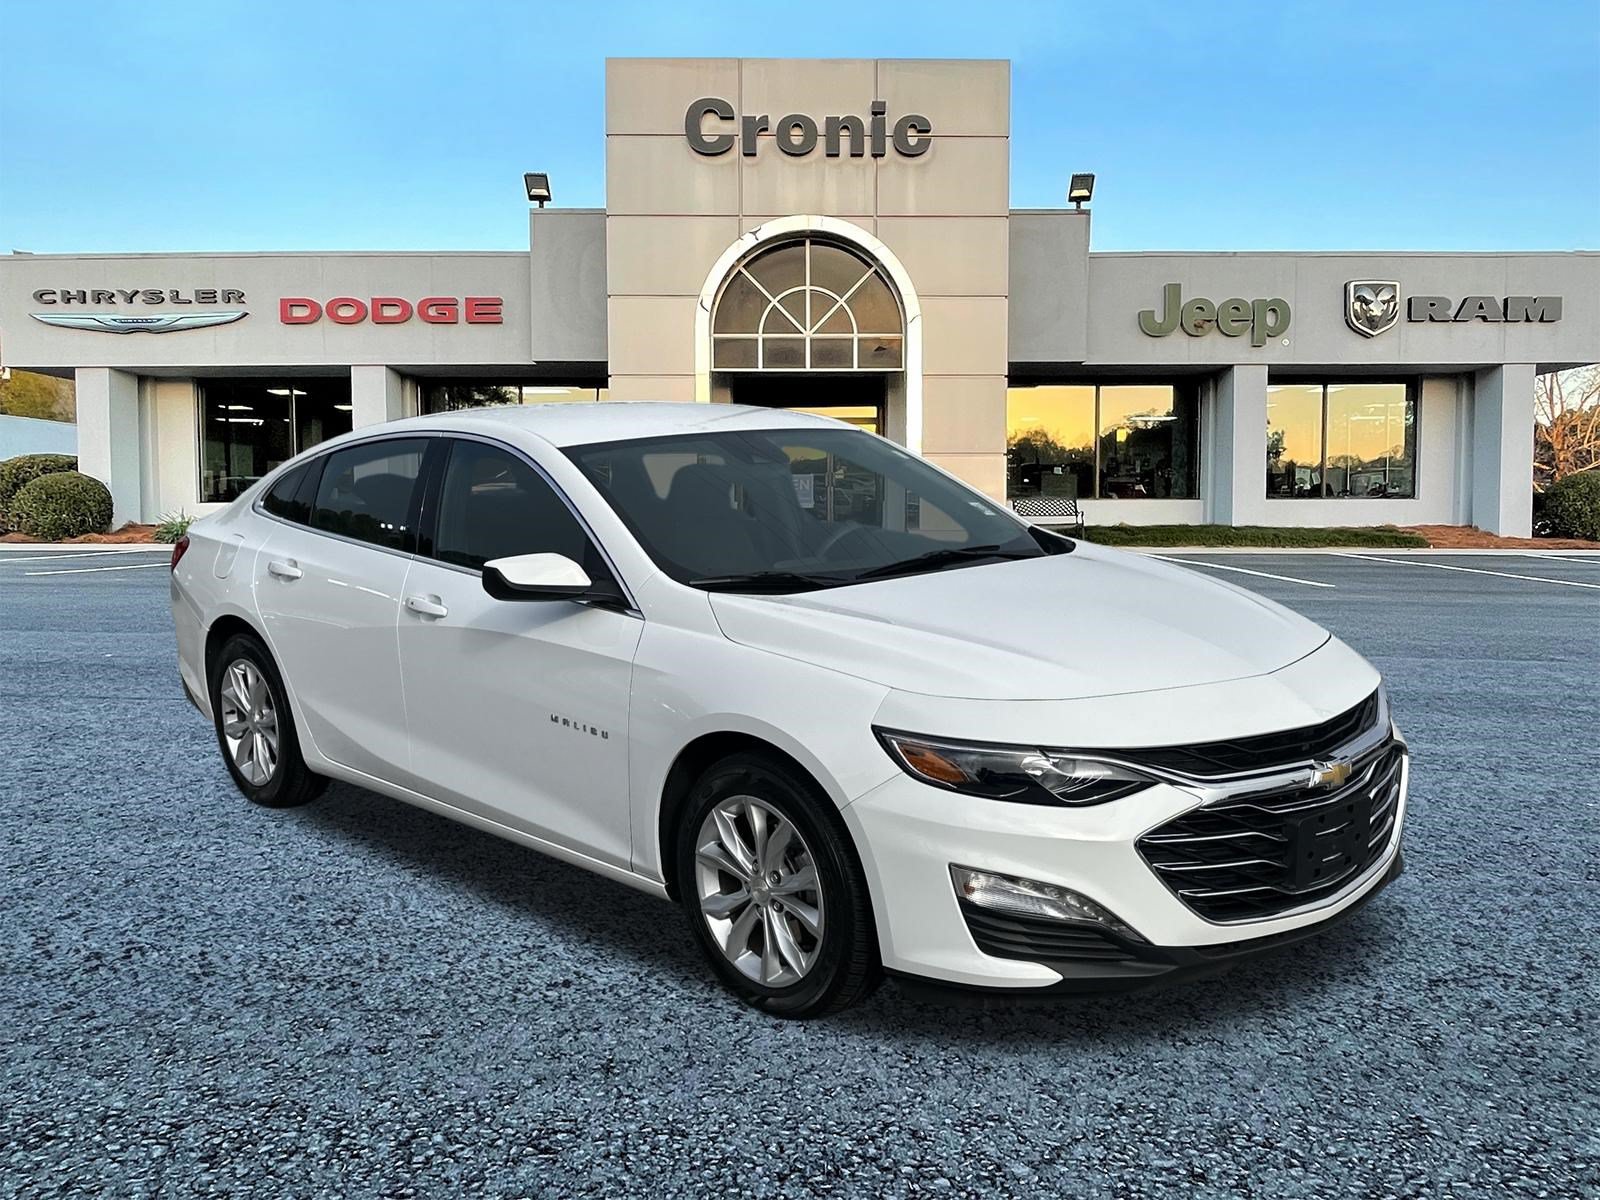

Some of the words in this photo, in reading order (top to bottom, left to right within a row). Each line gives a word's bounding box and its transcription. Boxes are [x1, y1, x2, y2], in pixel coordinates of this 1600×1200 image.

[685, 97, 932, 157] Cronic
[32, 289, 246, 304] CHRYSLER
[1407, 296, 1563, 322] RAM
[280, 297, 503, 324] DODGE
[1138, 283, 1291, 347] Jeep
